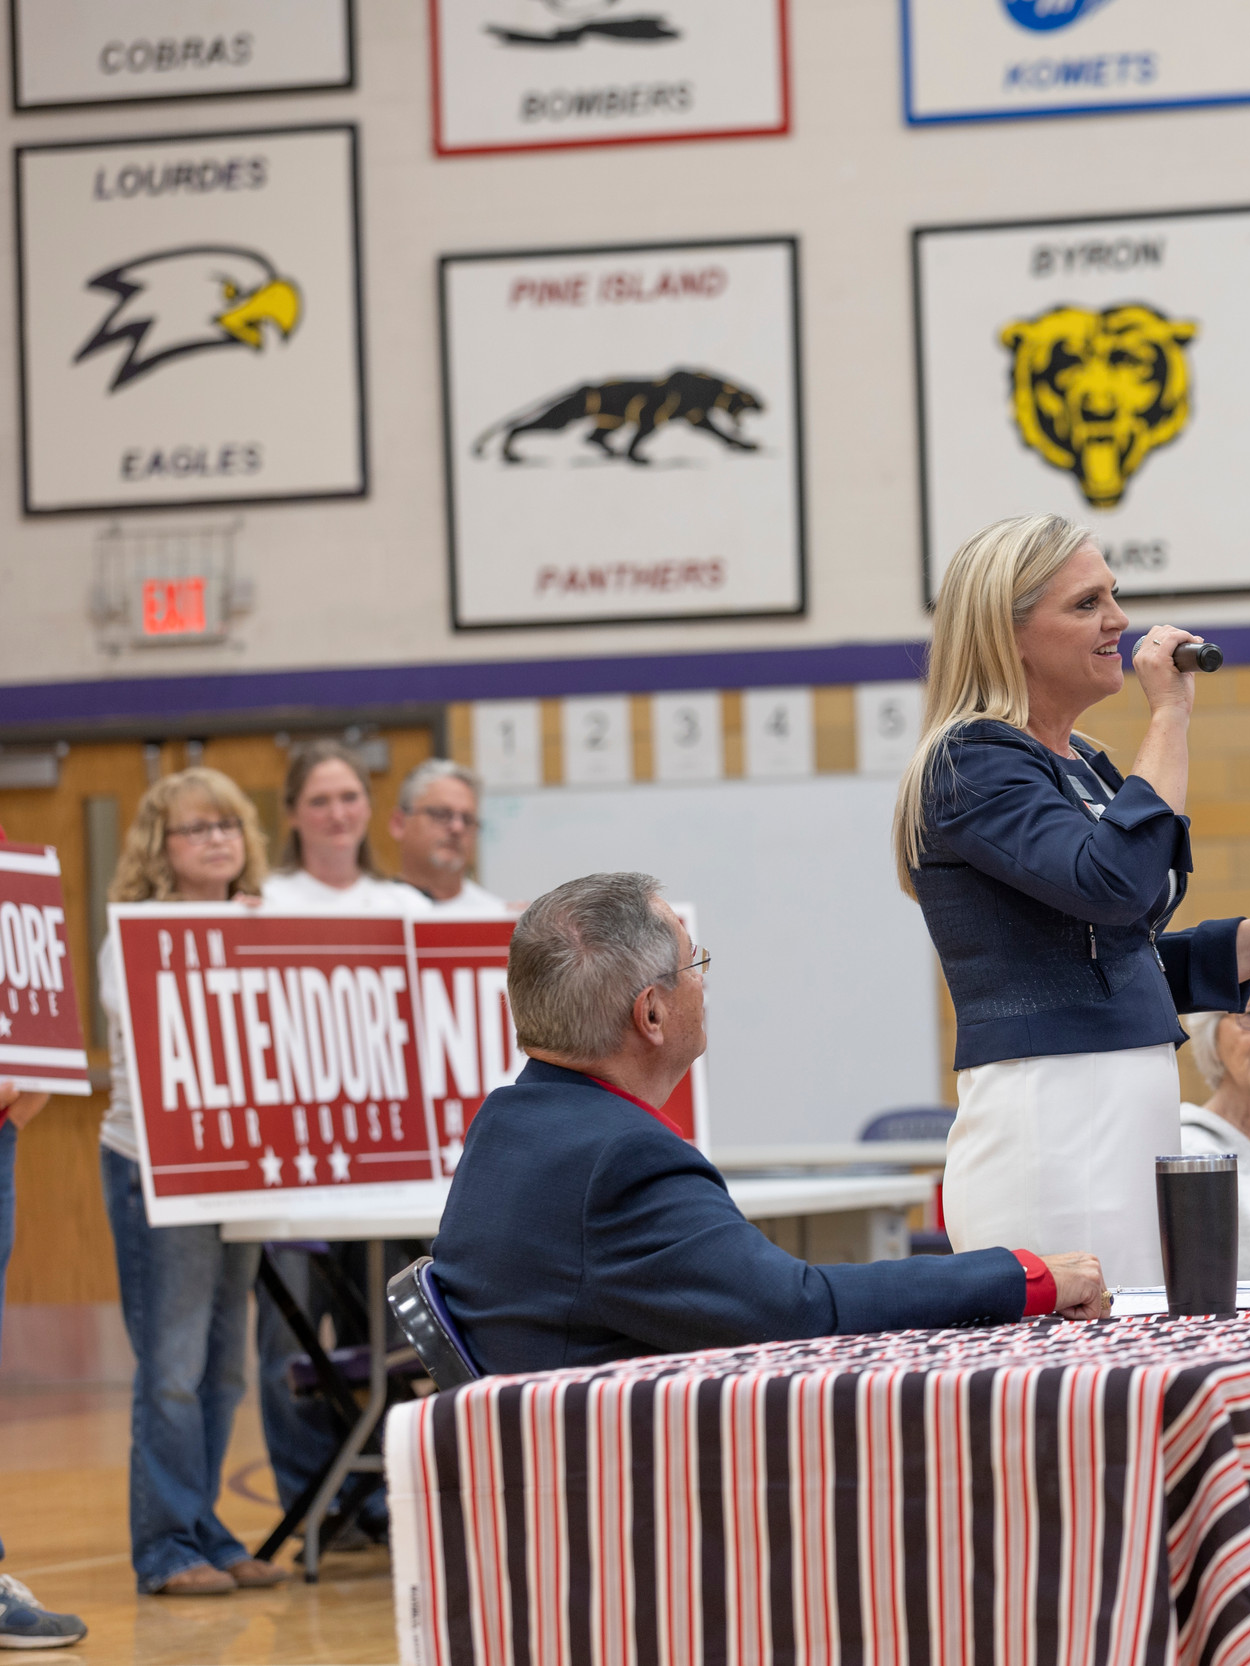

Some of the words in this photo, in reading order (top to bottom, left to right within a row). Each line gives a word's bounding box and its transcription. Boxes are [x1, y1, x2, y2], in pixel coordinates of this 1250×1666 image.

[100, 35, 254, 76] COBRAS
[1003, 51, 1159, 93] KOMETS
[520, 83, 694, 124] BOMBERS
[95, 156, 269, 202] LOURDES
[1031, 237, 1165, 278] BYRON
[509, 274, 591, 311] PINE
[599, 267, 729, 307] ISLAND
[121, 444, 264, 483] EAGLES
[535, 557, 726, 597] PANTHERS
[143, 576, 208, 636] EXIT
[499, 717, 517, 757] 1
[581, 708, 610, 752] 2
[674, 704, 700, 748] 3
[765, 701, 791, 743] 4
[876, 697, 905, 740] 5
[0, 900, 66, 992] ORF
[156, 964, 409, 1112] ALTENDORF
[191, 1107, 263, 1151] FOR
[292, 1101, 406, 1146] HOUSE
